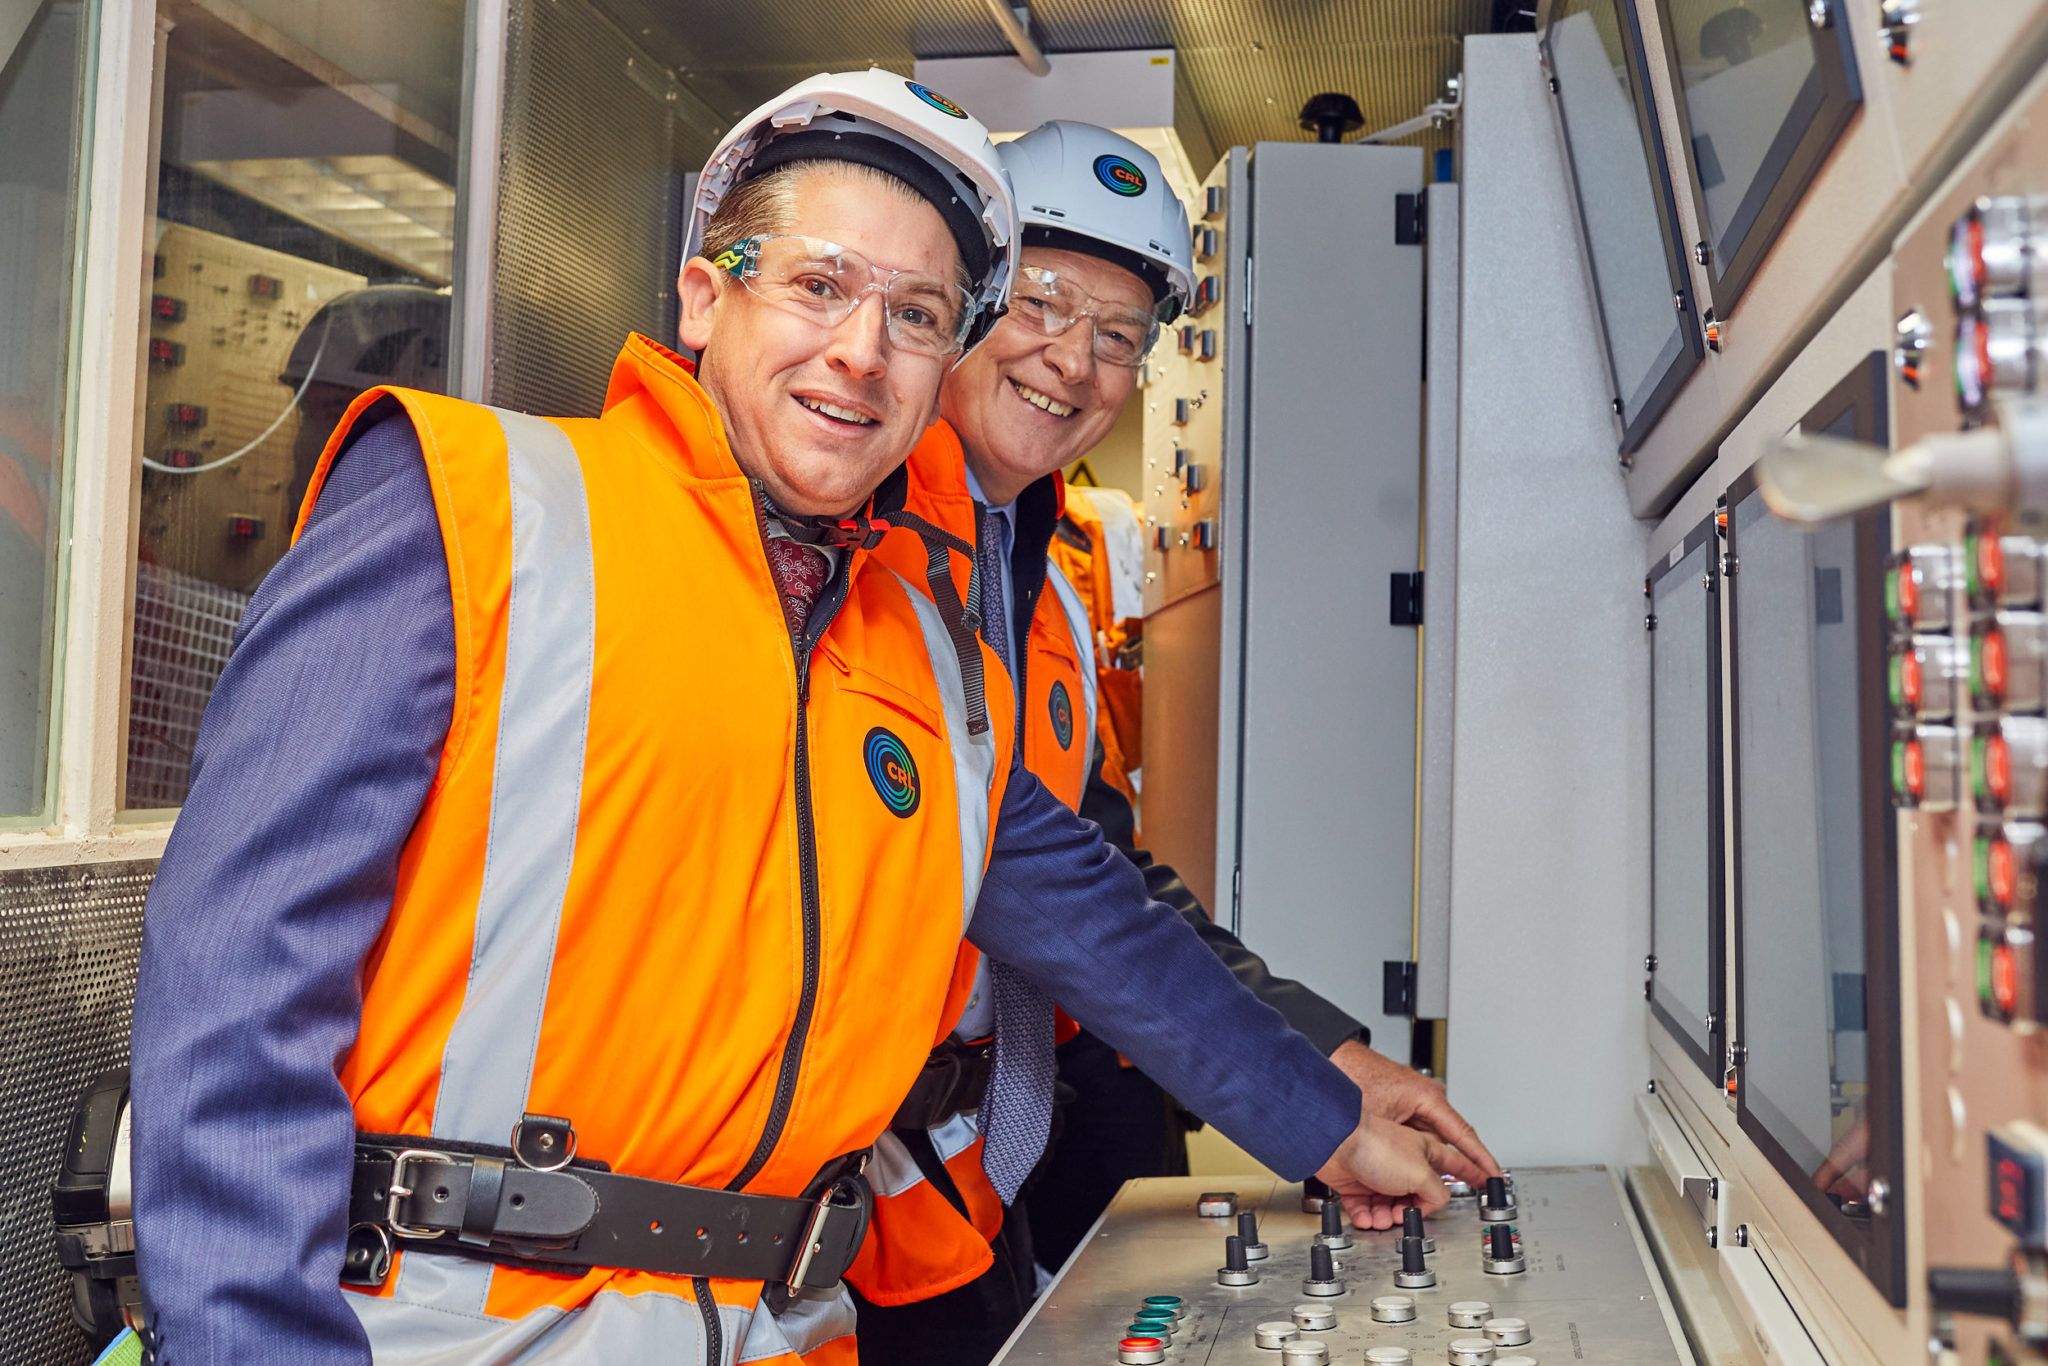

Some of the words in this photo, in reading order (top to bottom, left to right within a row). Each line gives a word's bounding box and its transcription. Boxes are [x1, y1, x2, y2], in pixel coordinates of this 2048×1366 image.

[931, 93, 963, 115] CRL
[1115, 169, 1143, 187] CRL
[887, 761, 916, 792] CRL
